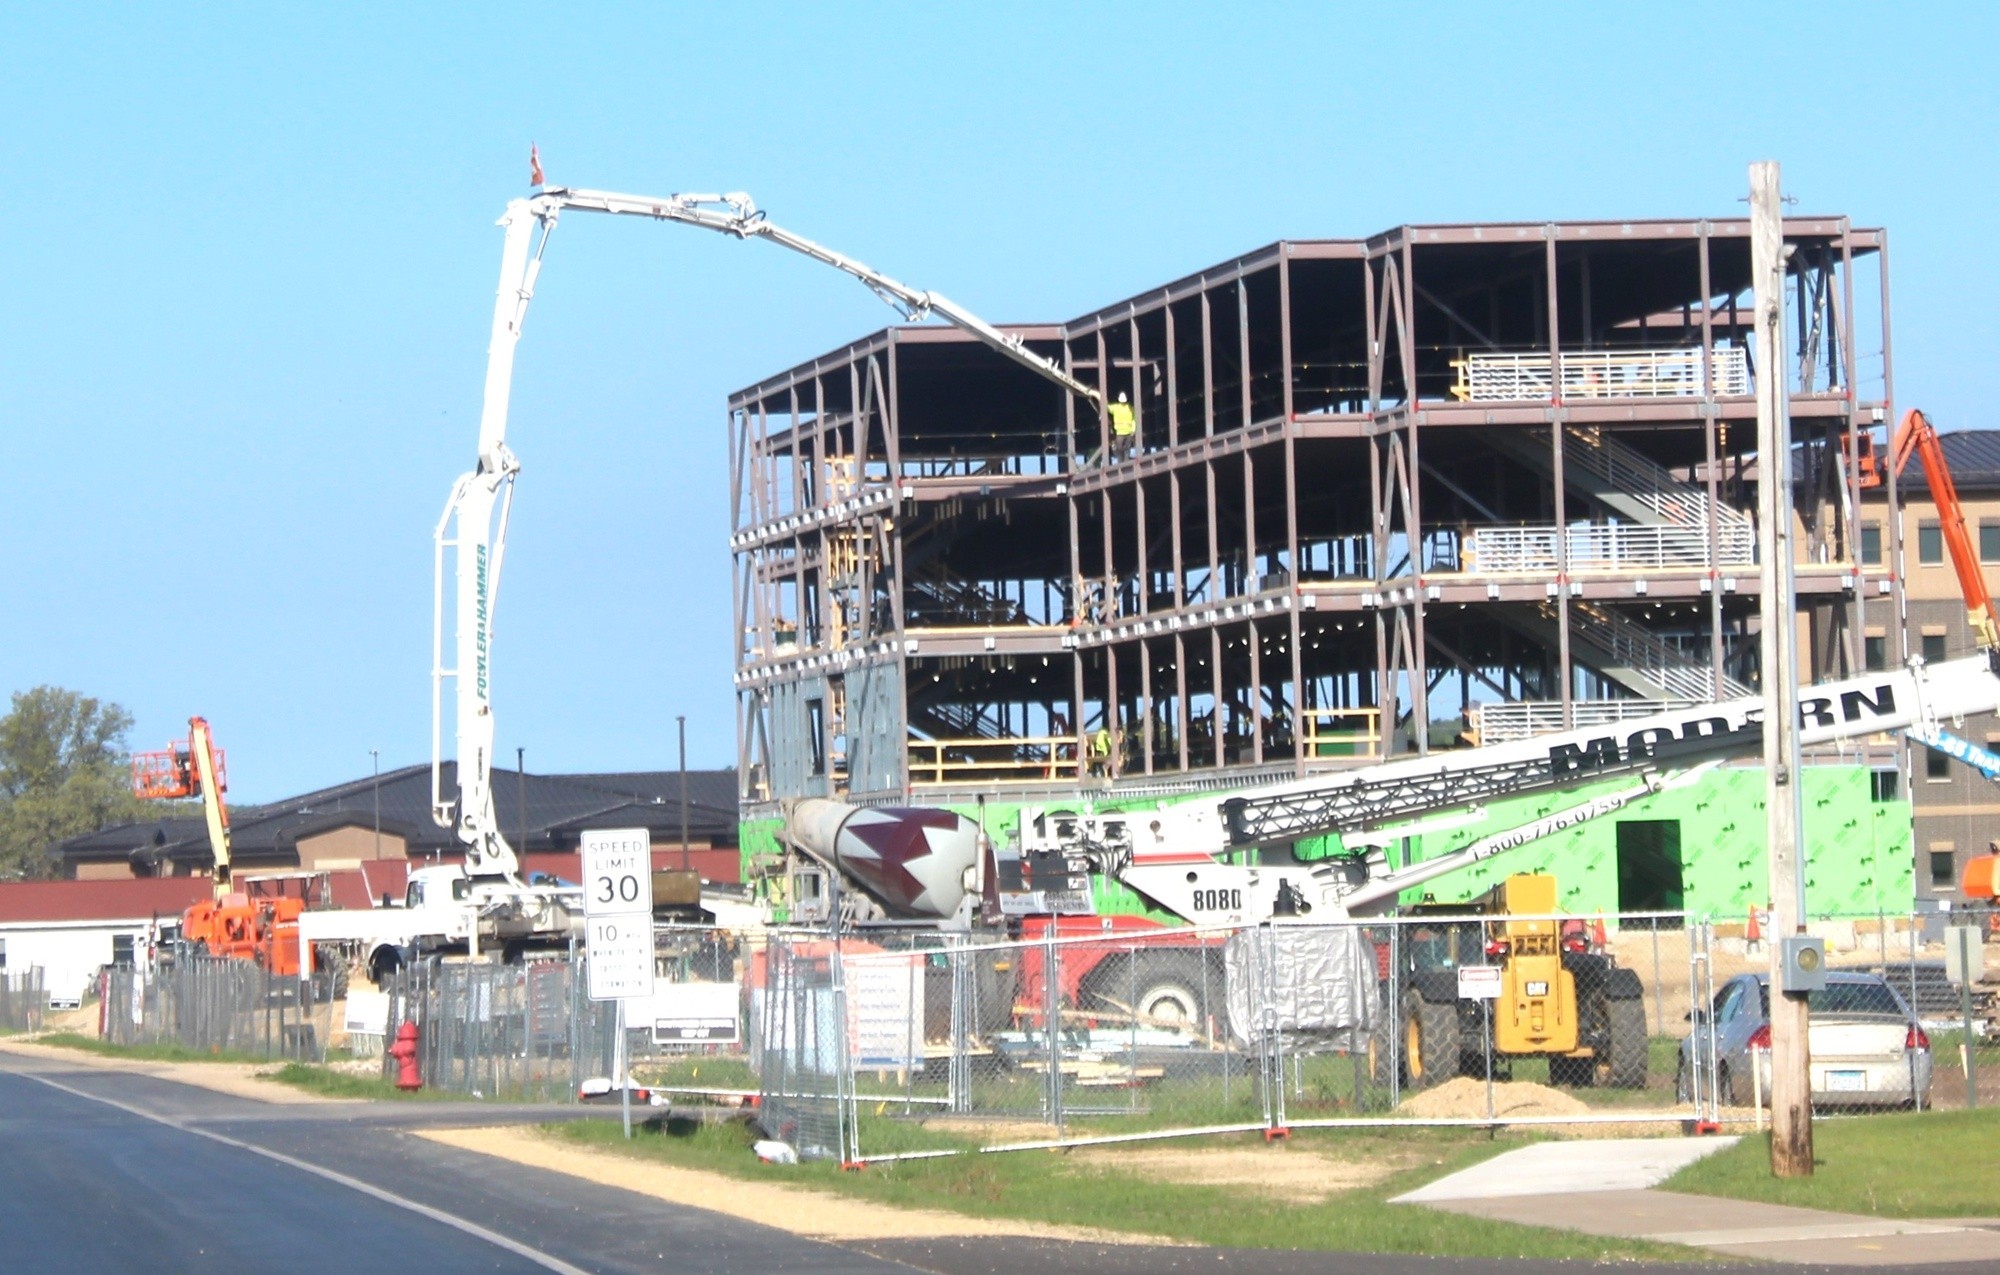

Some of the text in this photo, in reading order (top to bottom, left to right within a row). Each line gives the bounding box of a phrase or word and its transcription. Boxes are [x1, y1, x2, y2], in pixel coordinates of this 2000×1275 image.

[1472, 797, 1622, 861] 1-800-776-0759
[589, 840, 643, 853] SPEED
[595, 857, 636, 871] LIMIT
[597, 875, 639, 903] 30
[1193, 889, 1242, 912] 8080
[598, 925, 617, 941] 10
